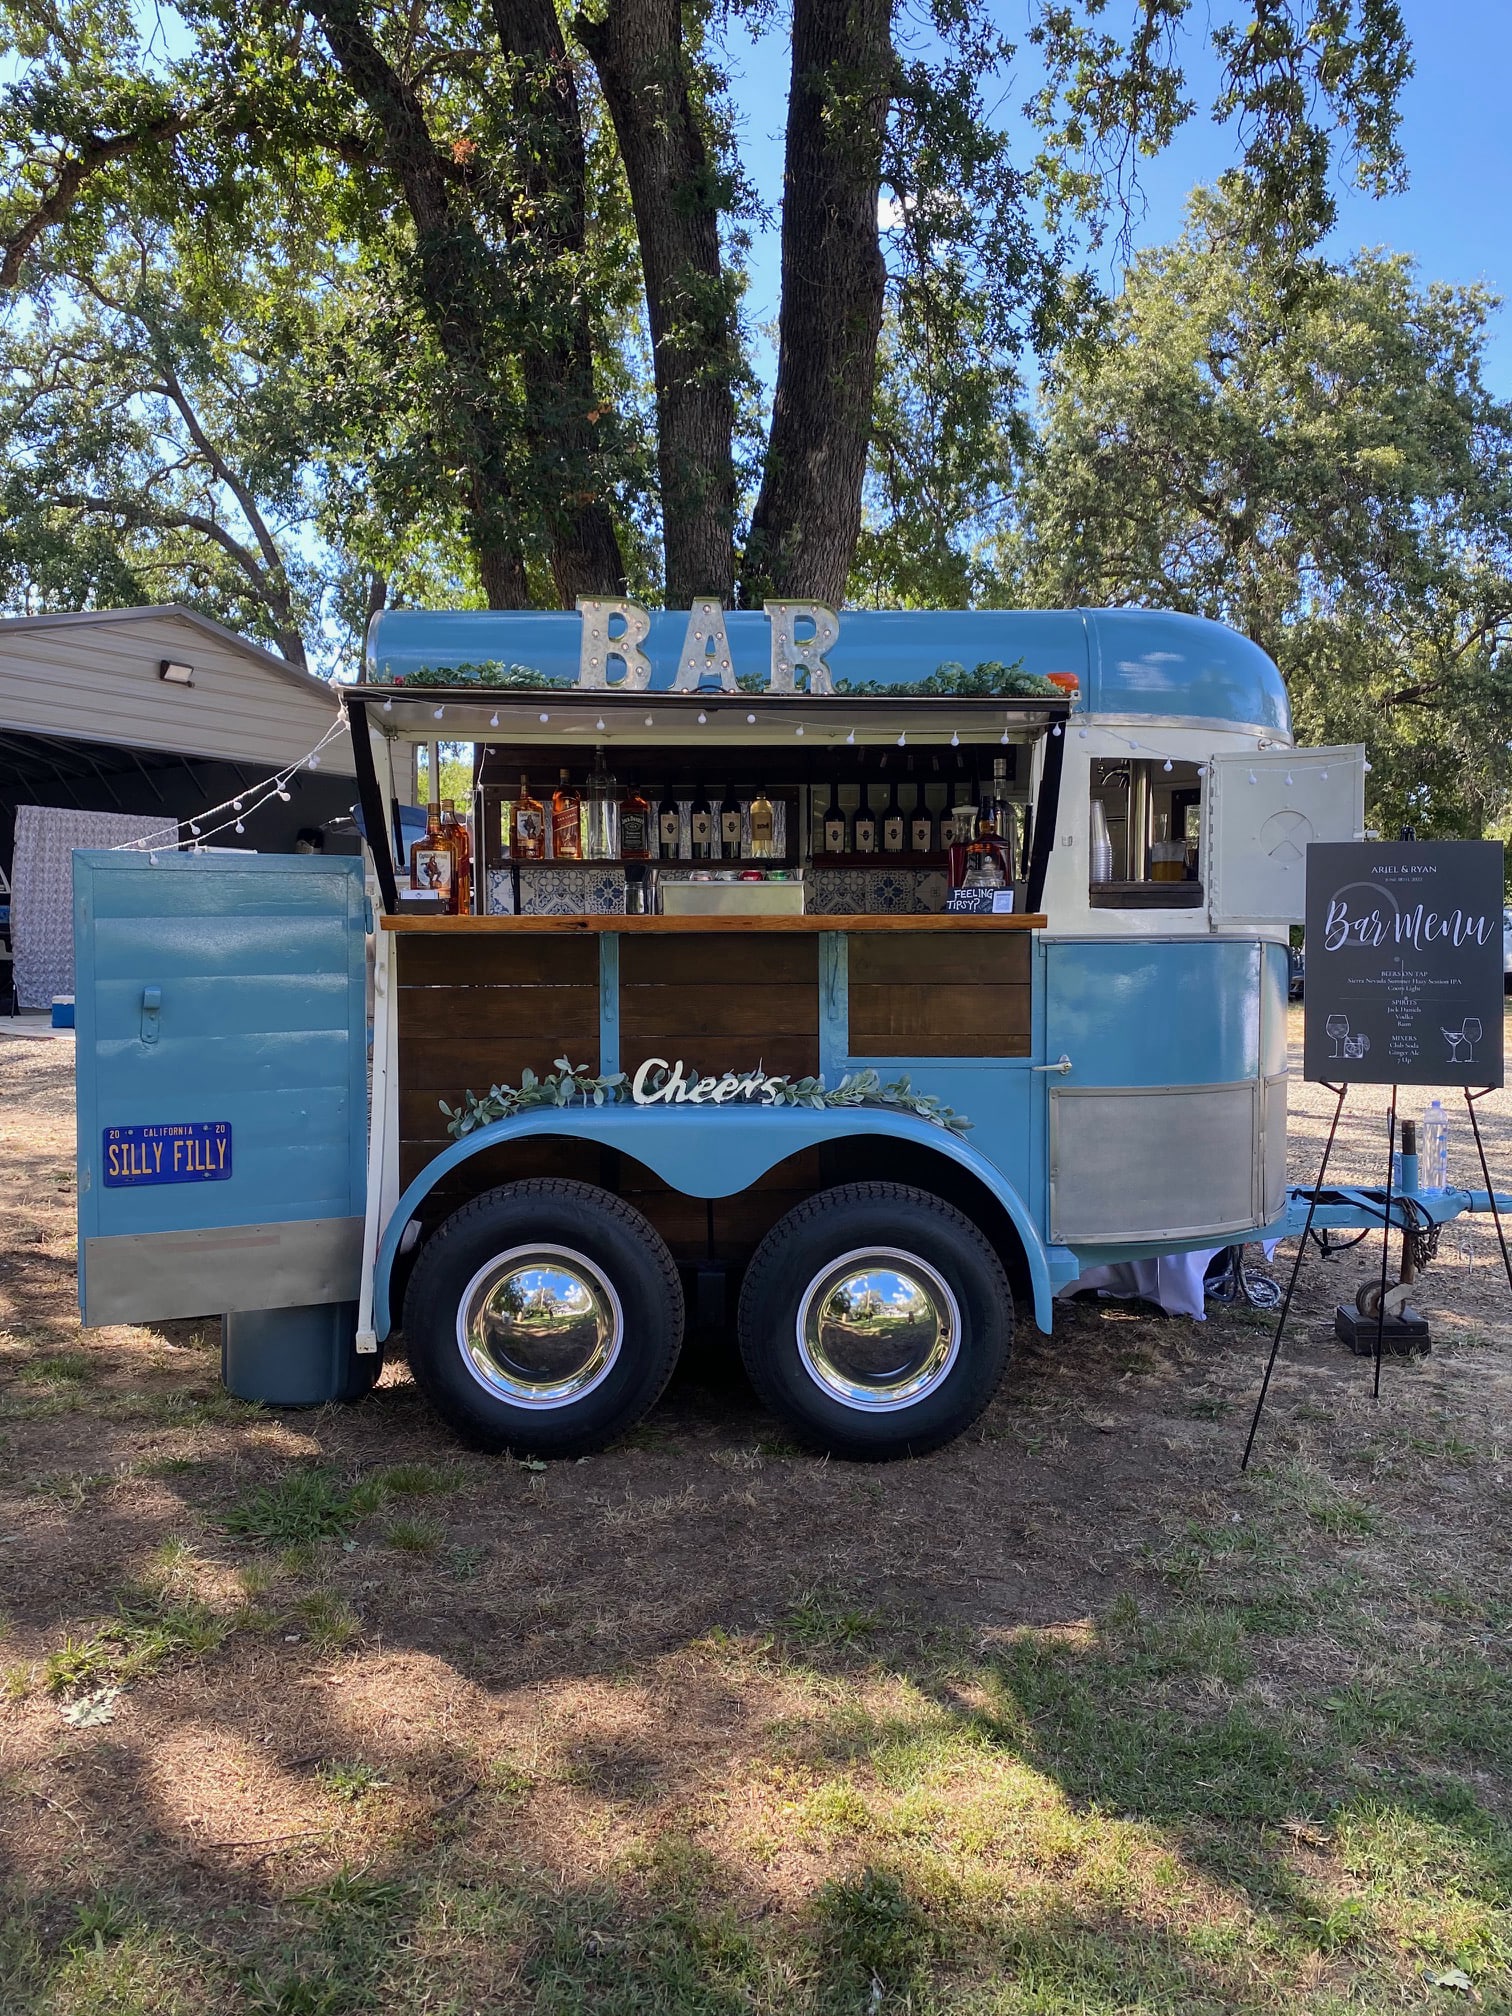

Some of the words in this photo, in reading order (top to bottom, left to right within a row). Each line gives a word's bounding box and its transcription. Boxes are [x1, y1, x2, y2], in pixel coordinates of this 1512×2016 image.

[576, 594, 840, 695] BAR
[1371, 866, 1399, 874] ARIEL
[1401, 864, 1408, 874] &
[1410, 865, 1437, 873] RYAN
[946, 898, 980, 913] TIPSY?
[954, 889, 993, 901] FEELING
[1324, 900, 1391, 951] Bar
[1395, 904, 1495, 951] Menu
[632, 1057, 783, 1104] Cheers
[109, 1130, 120, 1139] 20
[143, 1126, 193, 1138] CALIFORNIA
[215, 1124, 226, 1134] 20
[109, 1142, 163, 1176] SILLY
[174, 1138, 227, 1172] FILLY
